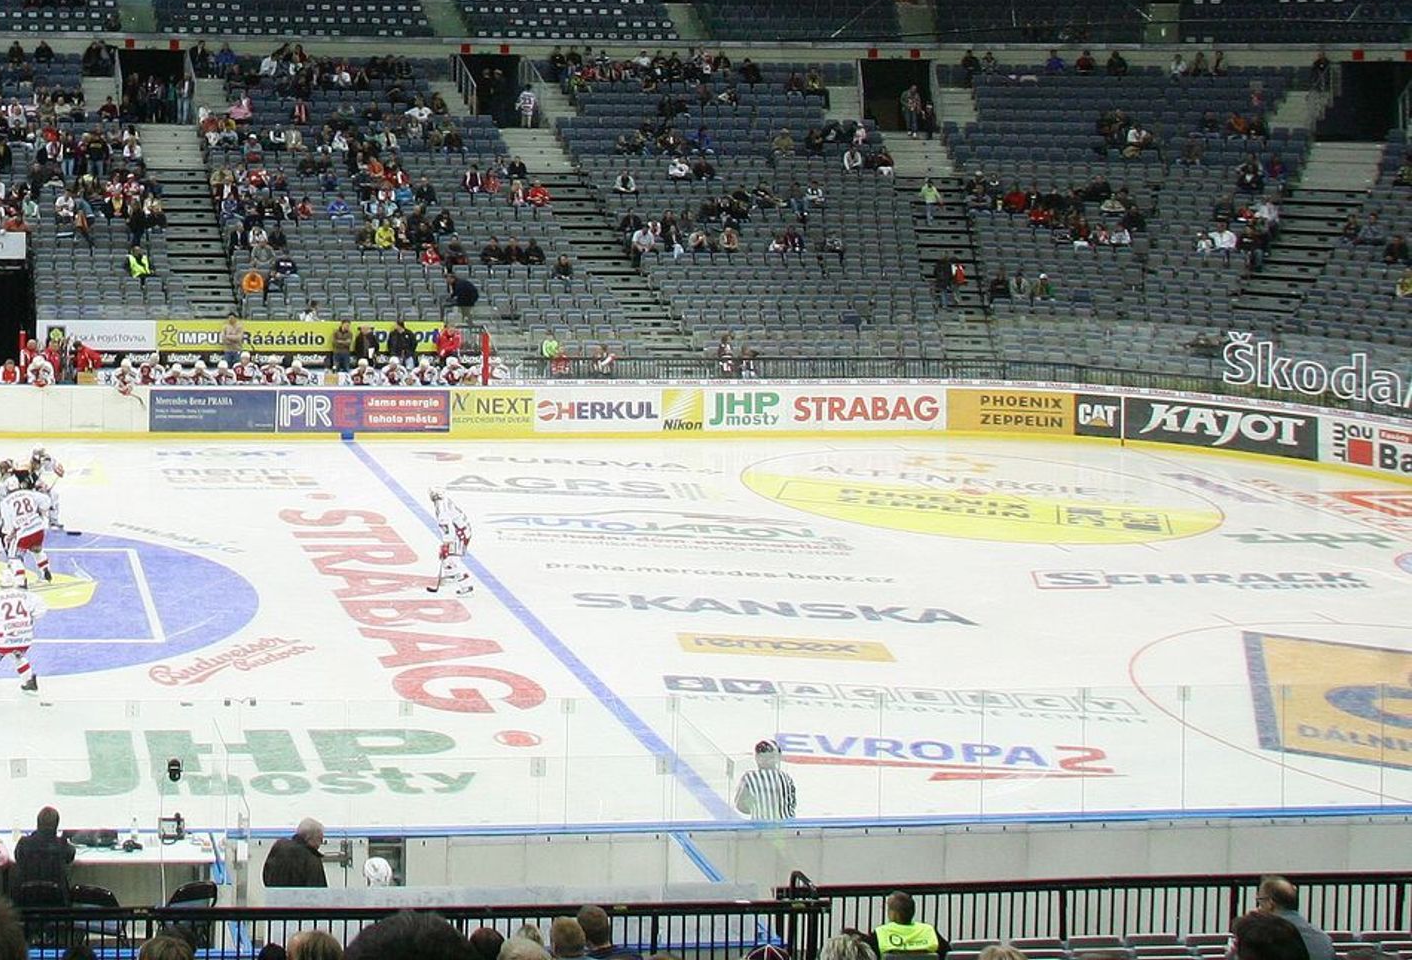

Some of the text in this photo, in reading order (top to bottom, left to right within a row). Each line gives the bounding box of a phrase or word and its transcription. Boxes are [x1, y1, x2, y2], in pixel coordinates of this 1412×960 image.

[179, 331, 223, 345] IMPU
[279, 394, 357, 428] PRE
[476, 398, 533, 415] NEXT
[560, 401, 659, 421] HERKUL
[709, 392, 780, 426] JHP
[793, 395, 940, 422] STRABAG
[980, 394, 1063, 410] PHOENIX
[662, 419, 704, 431] Nikon
[725, 412, 780, 427] mosty
[980, 414, 1064, 429] ZEPPELIN
[1078, 404, 1118, 426] CAT
[1140, 404, 1306, 446] KAJOT
[13, 497, 34, 516] 28
[836, 496, 1031, 520] ZEPPELIN
[838, 487, 1028, 511] PHOENIX
[1041, 571, 1366, 588] SCHRACK
[1, 600, 29, 621] 24
[277, 506, 548, 714] STRABAG
[571, 592, 980, 627] SKANSKA
[148, 634, 290, 687] Budweiser
[231, 642, 316, 672] Budvar
[53, 729, 458, 797] JHP
[774, 732, 1115, 773] EVROPA 2
[178, 766, 477, 797] mosty
